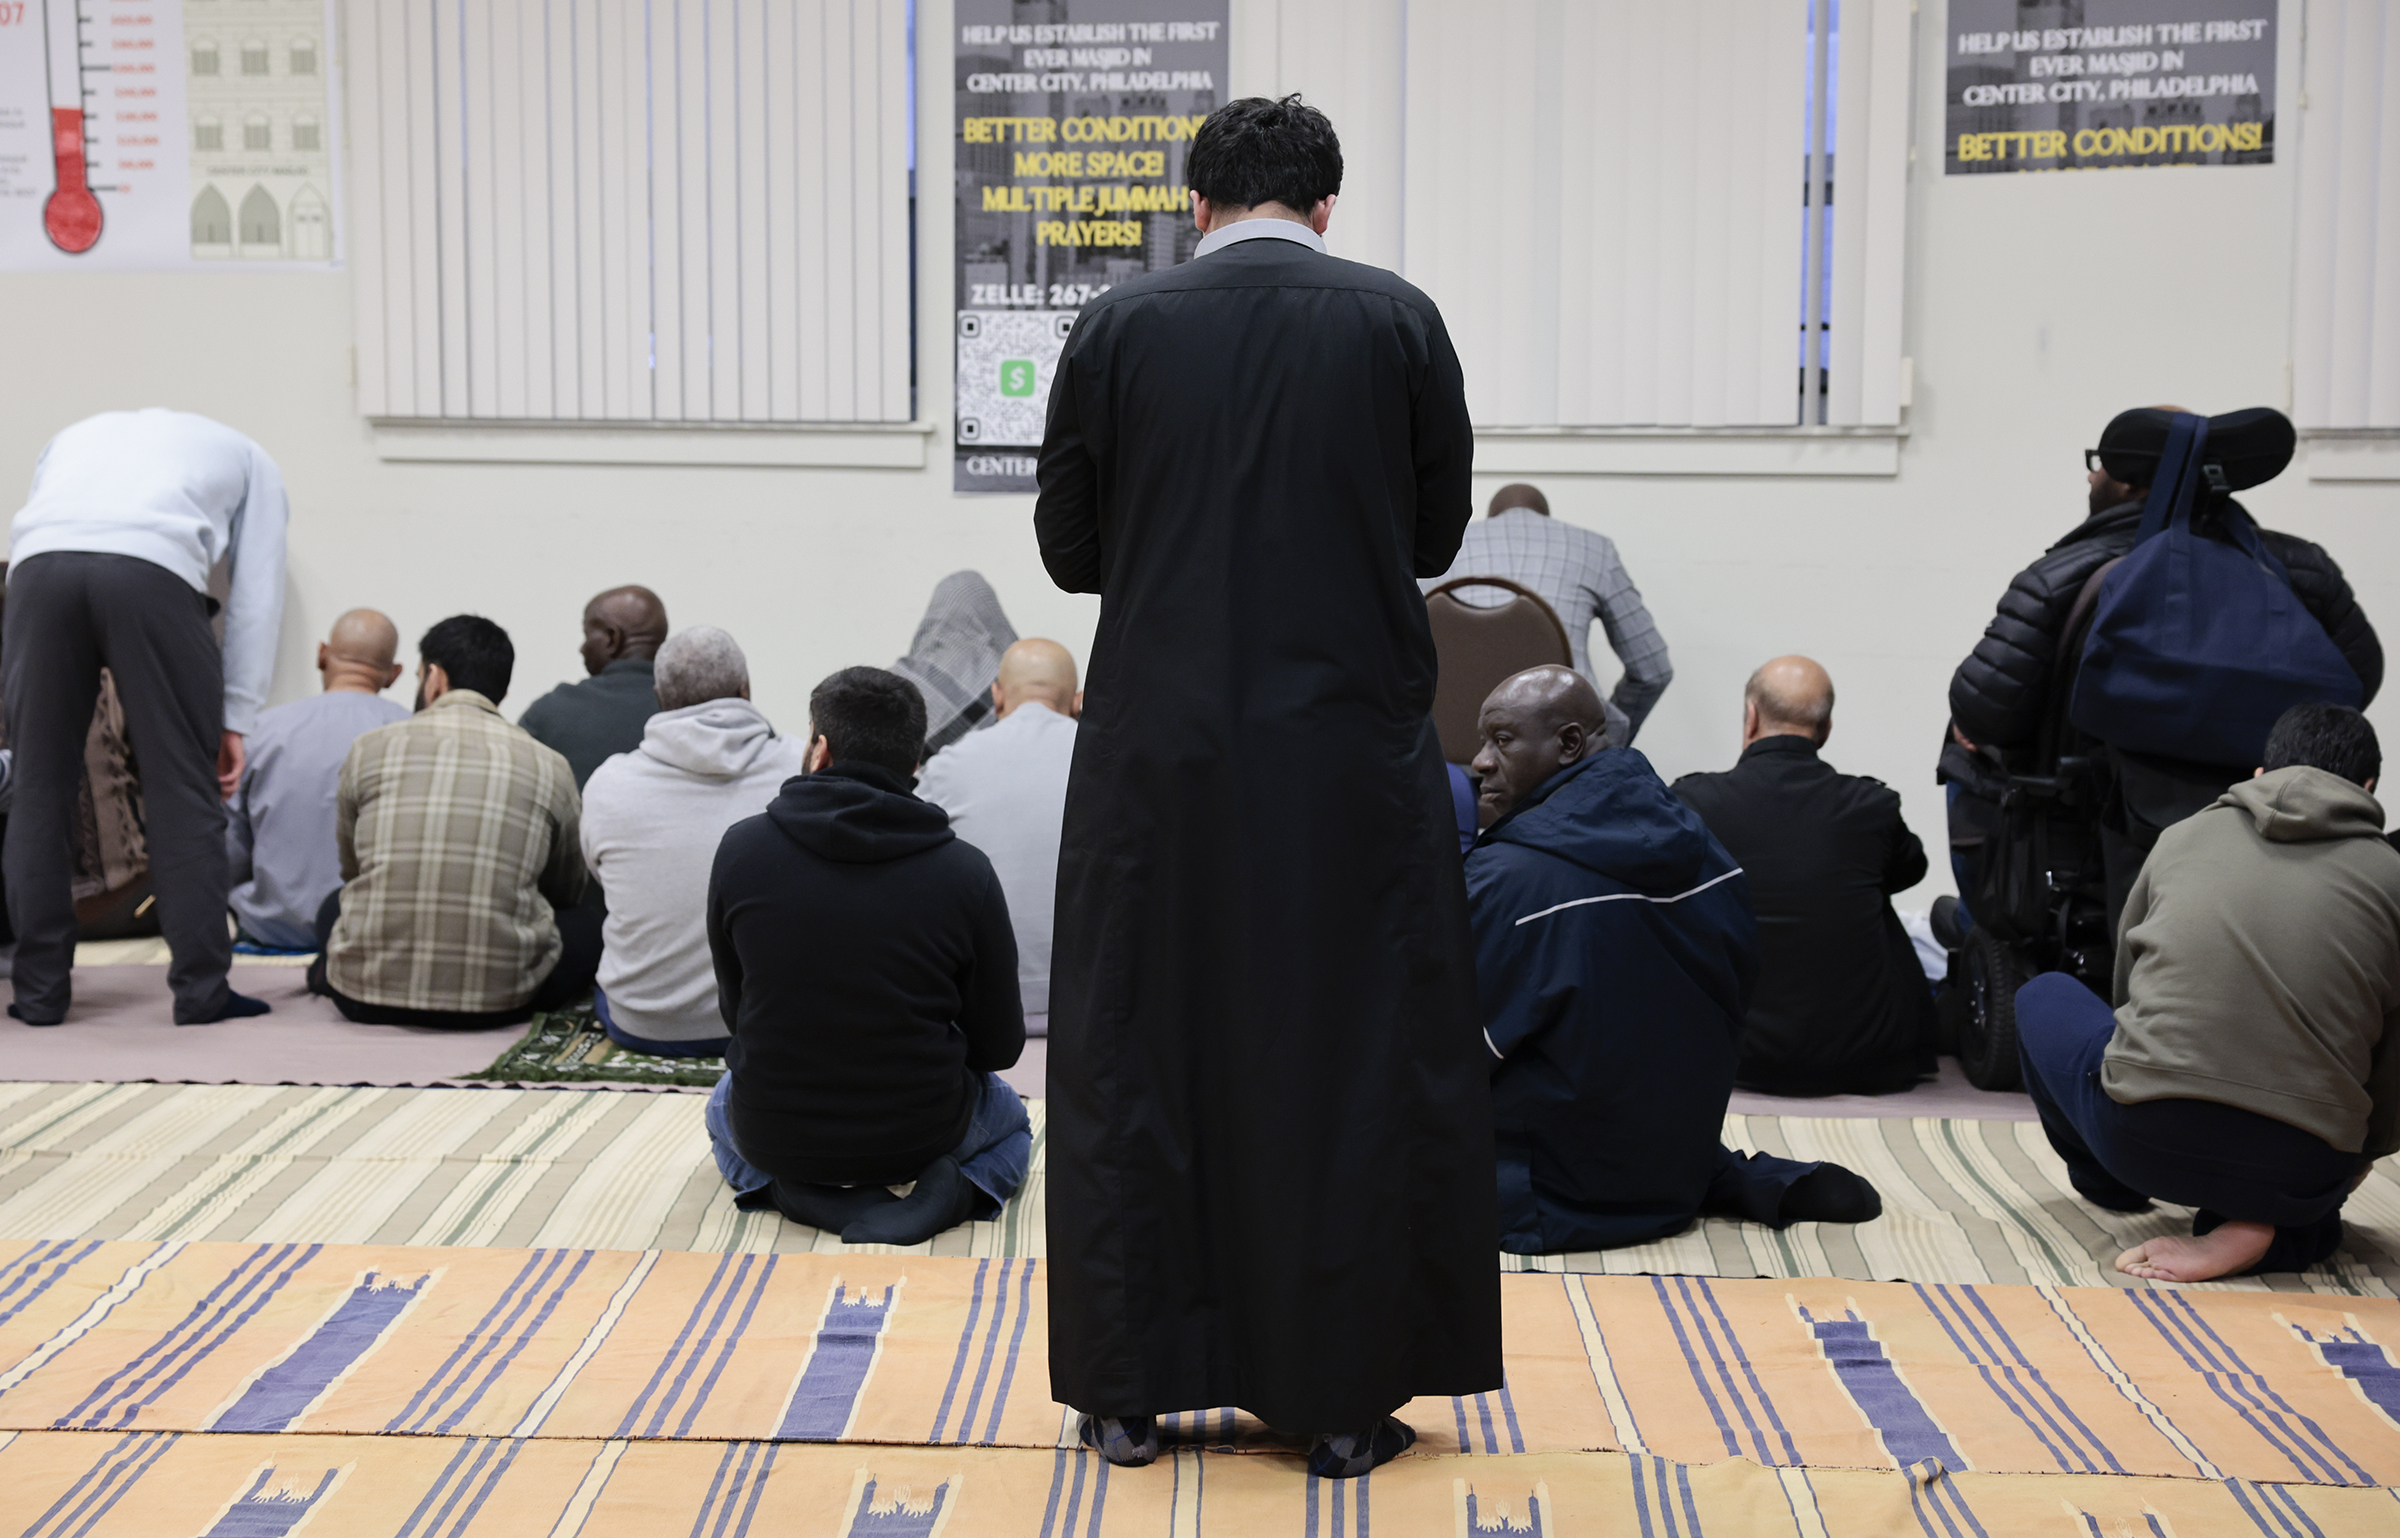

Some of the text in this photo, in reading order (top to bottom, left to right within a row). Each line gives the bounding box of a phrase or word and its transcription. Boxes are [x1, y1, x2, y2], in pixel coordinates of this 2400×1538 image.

[962, 21, 1220, 44] HELP US ESTABLISH THE FIRST
[1958, 19, 2268, 54] HELP US ESTABLISH THE FIRST
[1023, 47, 1152, 71] EVER MASJID IN
[2029, 50, 2185, 77] EVER MASJID IN
[966, 71, 1214, 94] CENTER CITY, PHILADELPHIA
[1962, 73, 2260, 108] CENTER CITY, PHILADELPHIA
[963, 115, 1208, 143] BETTER CONDITION
[1958, 121, 2264, 162] BETTER CONDITIONS!
[1014, 151, 1165, 177] MORE SPACE!
[982, 185, 1190, 216] MULTIPLE JUMMAH
[1036, 220, 1143, 247] PRAYERS!
[970, 283, 1044, 306] ZELLE:
[966, 455, 1038, 477] CENTER
